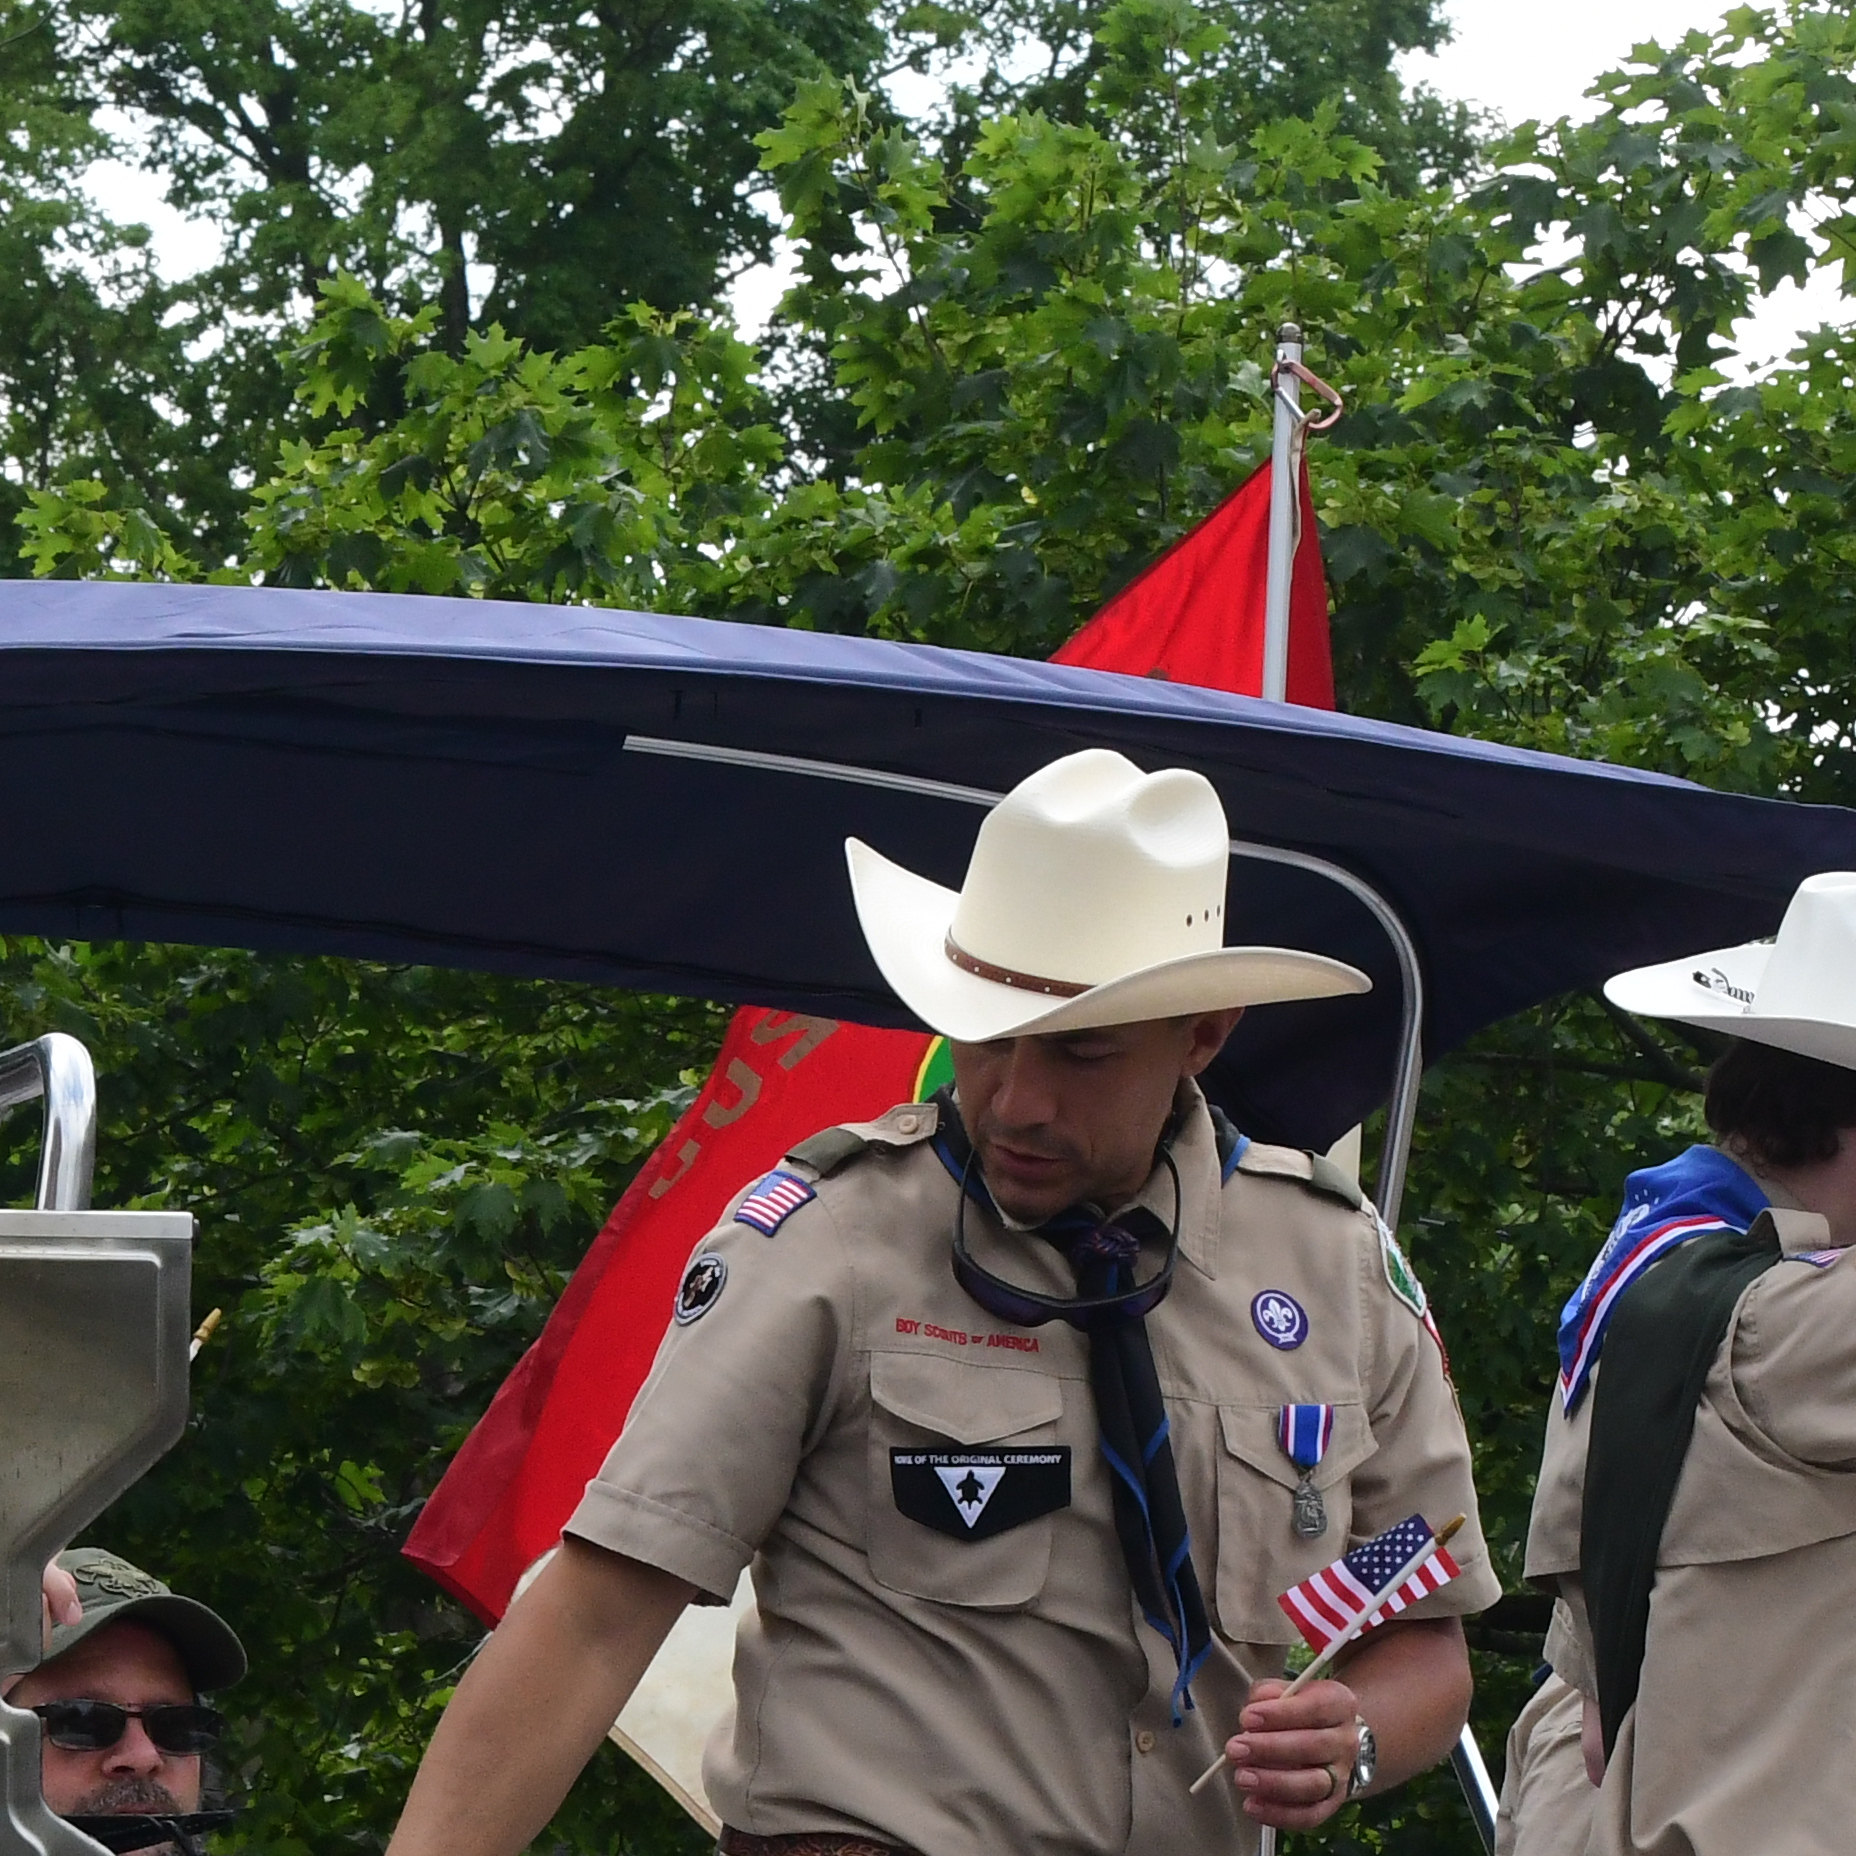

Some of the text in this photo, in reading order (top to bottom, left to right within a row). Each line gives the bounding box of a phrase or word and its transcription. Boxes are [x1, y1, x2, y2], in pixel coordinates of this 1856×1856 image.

[896, 1318, 921, 1335] BOY
[924, 1324, 968, 1346] SCOUTS
[986, 1333, 1040, 1352] AMERICA
[914, 1455, 927, 1464] OF
[929, 1454, 949, 1464] THE
[951, 1455, 1002, 1464] ORIGINAL
[1003, 1454, 1062, 1464] CEREMONY
